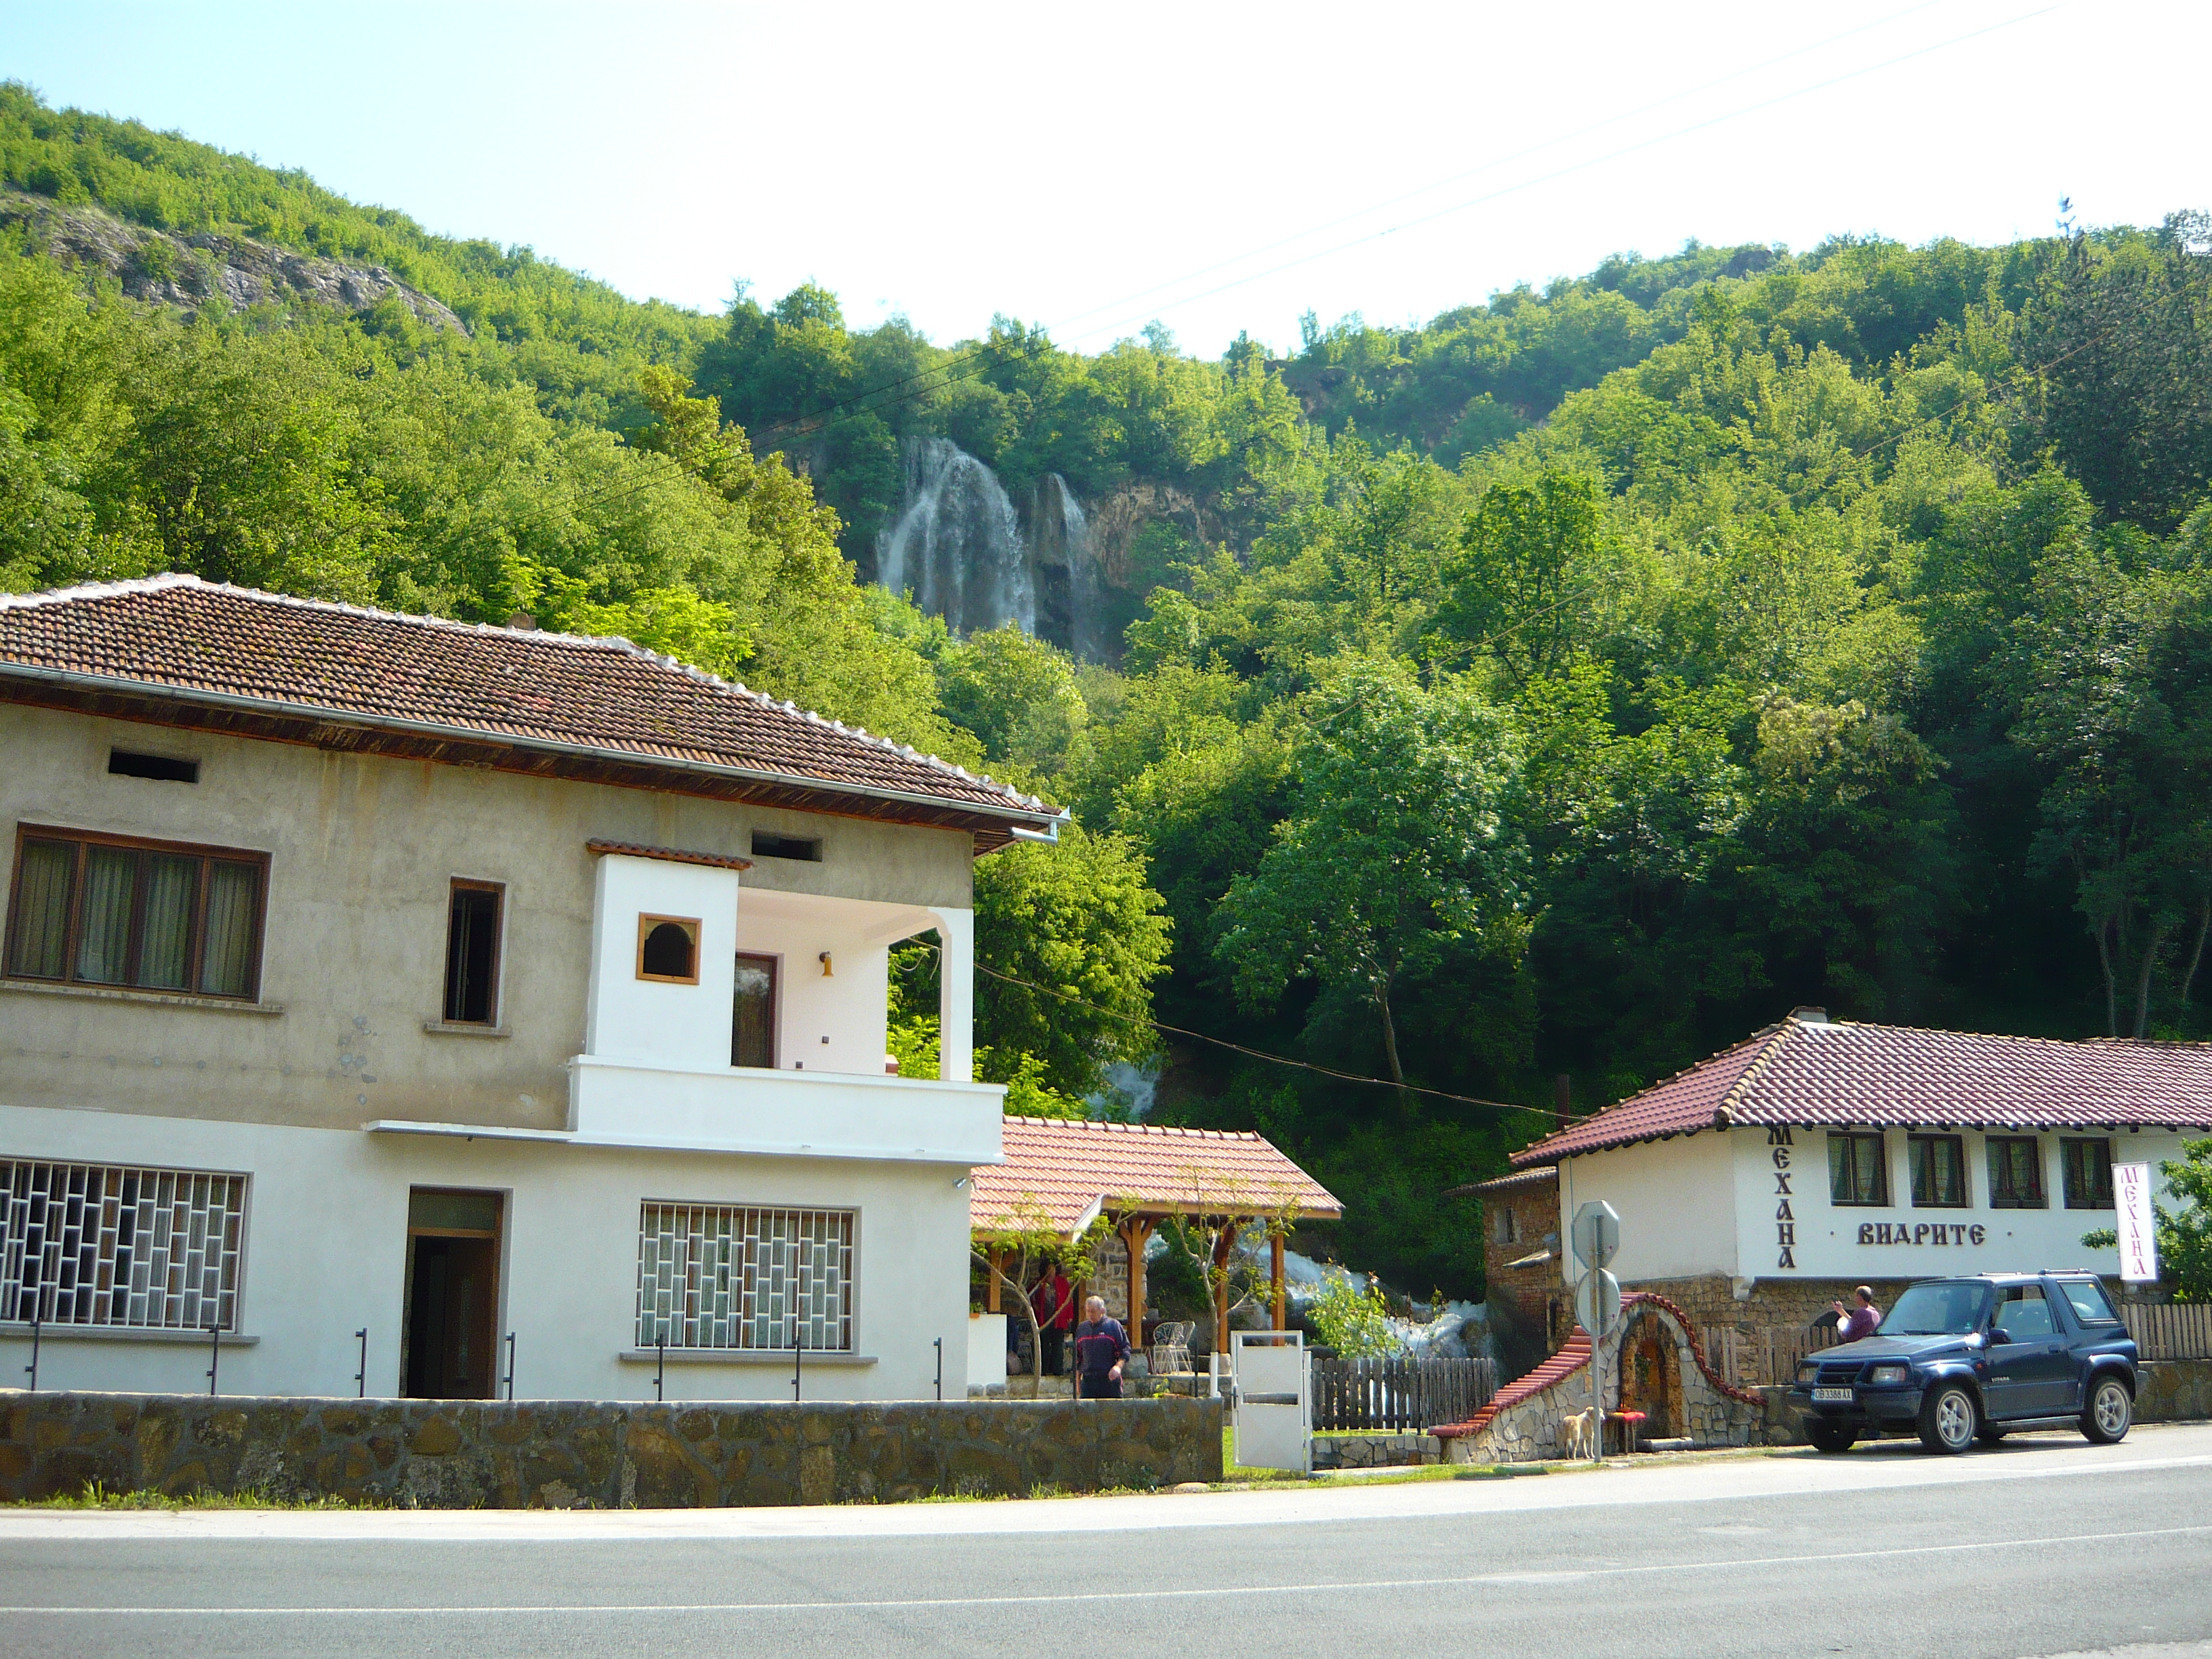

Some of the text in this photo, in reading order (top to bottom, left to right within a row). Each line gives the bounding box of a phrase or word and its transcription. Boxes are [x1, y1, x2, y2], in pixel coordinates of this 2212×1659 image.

[1767, 1123, 1796, 1269] МЕХАНА
[1856, 1223, 1986, 1246] ВИДРИТЕ
[2121, 1167, 2147, 1275] МЕХАНА
